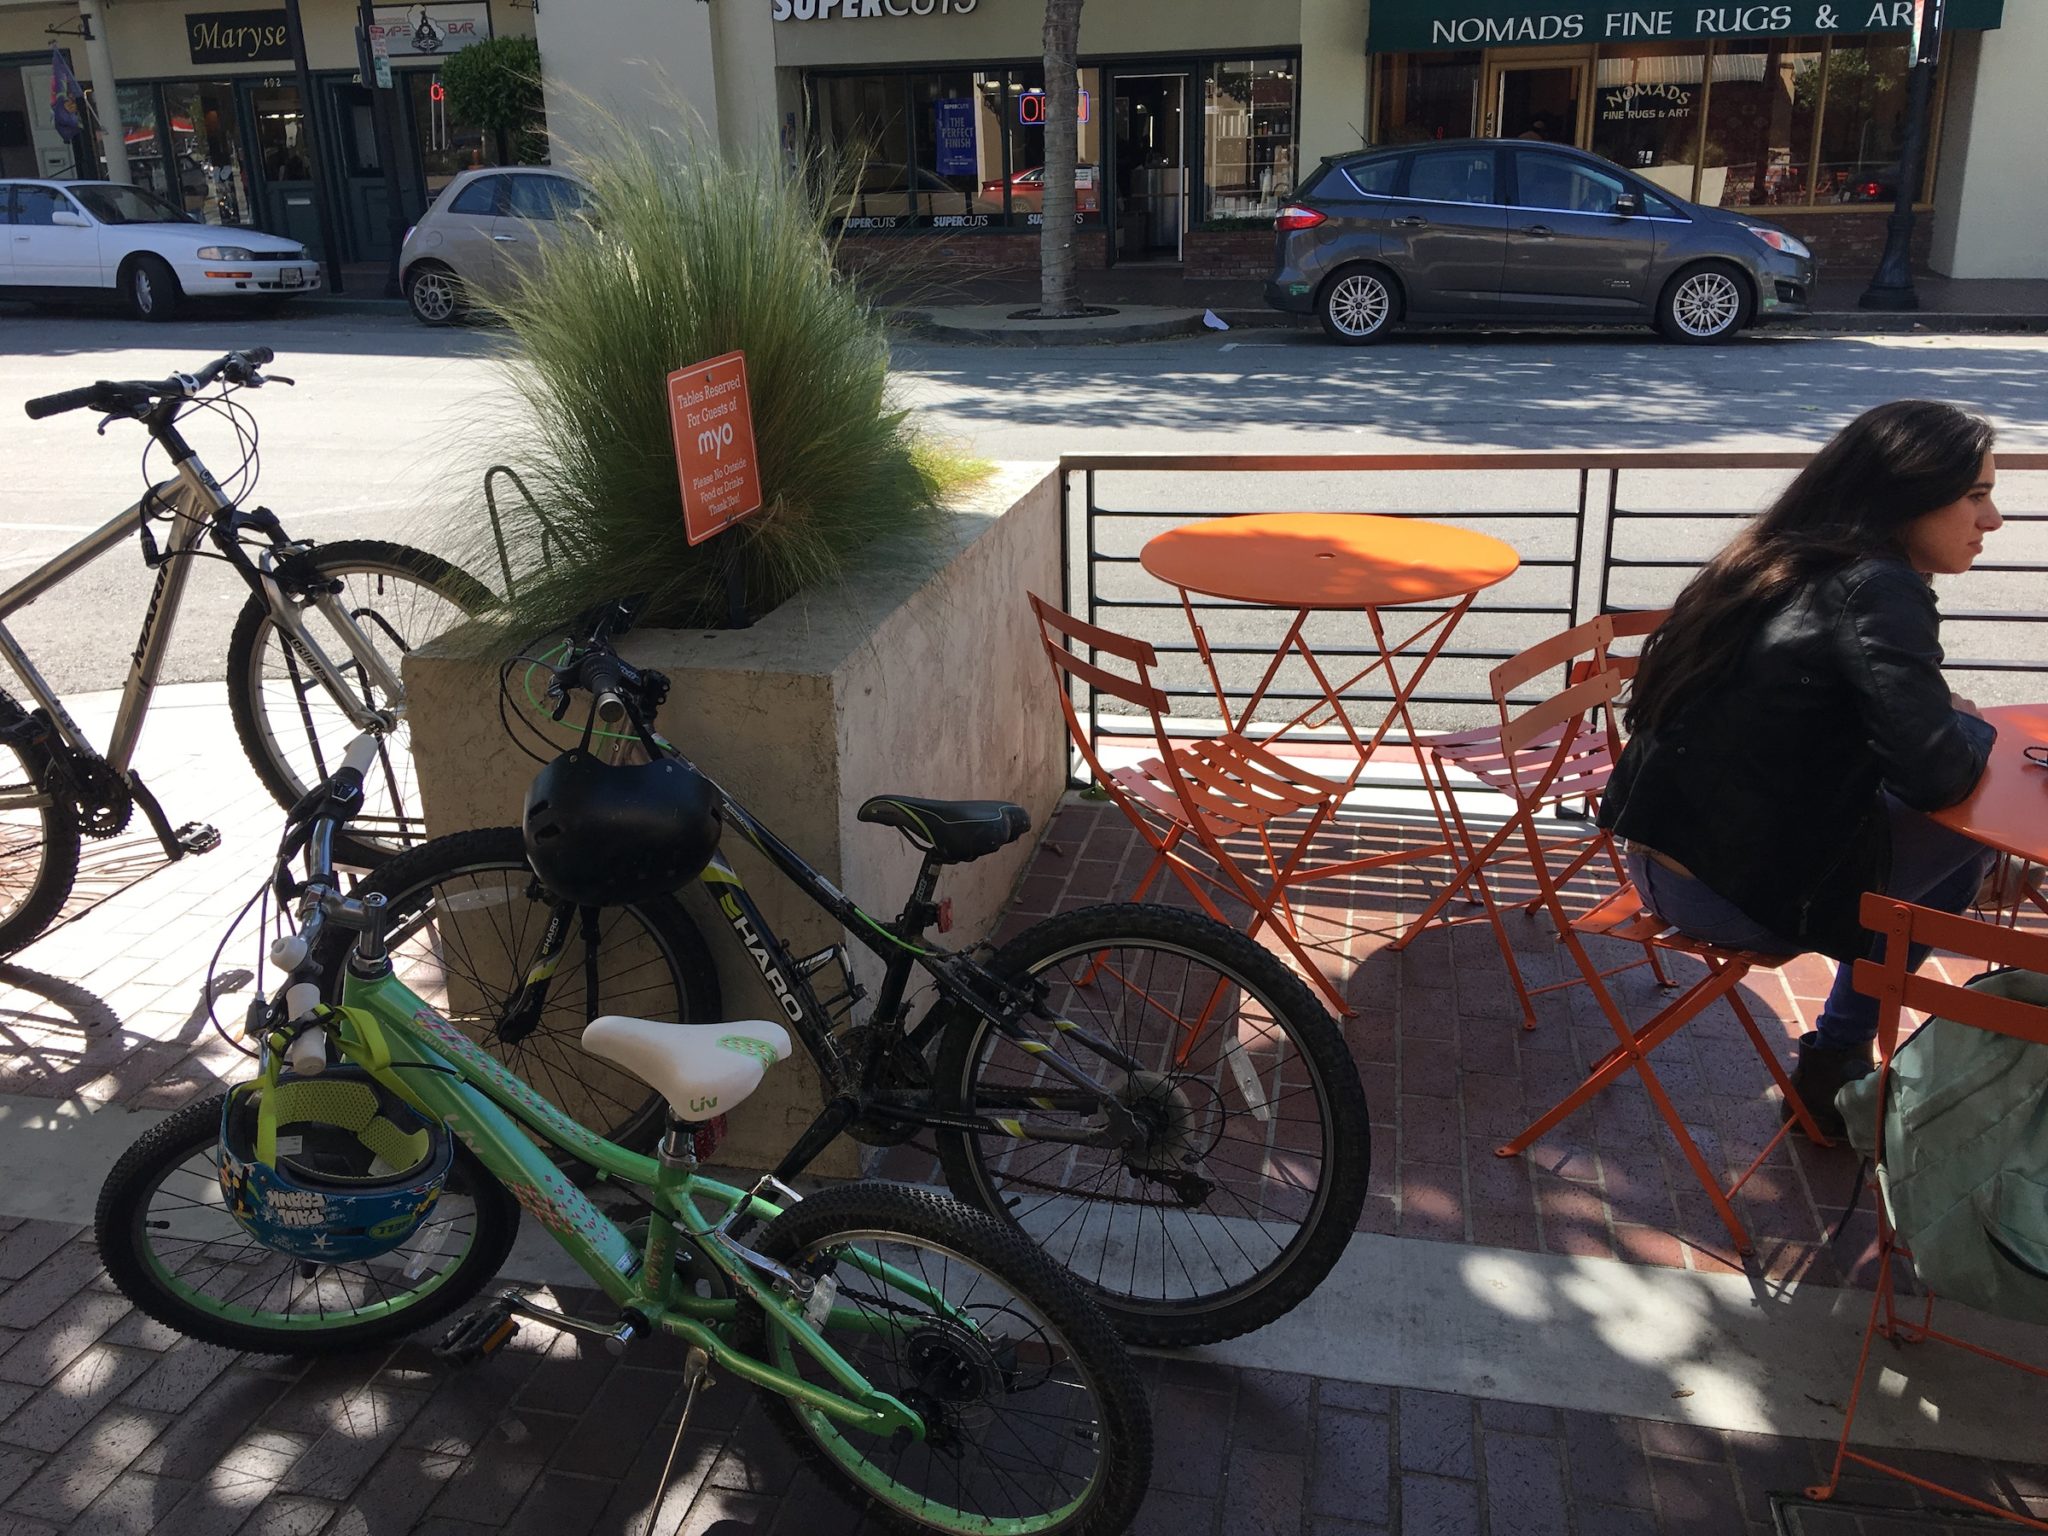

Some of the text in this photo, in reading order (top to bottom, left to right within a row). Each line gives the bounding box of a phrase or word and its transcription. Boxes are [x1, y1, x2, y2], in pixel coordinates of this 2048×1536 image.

[385, 22, 477, 37] APE BAR
[1432, 1, 1914, 43] NOMADS FINE RUGS & AR
[193, 21, 287, 57] Maryse
[1605, 83, 1691, 107] NOMADS
[950, 117, 965, 128] THE
[1602, 110, 1625, 120] FINE
[1627, 109, 1656, 119] RUGS
[1667, 108, 1690, 118] ART
[942, 127, 973, 138] PERFECT
[944, 138, 971, 149] FINISH
[933, 215, 988, 227] SUPERCUTS
[677, 374, 741, 409] Tables Reserved
[687, 396, 737, 428] For Guests of
[698, 422, 733, 460] myo
[693, 458, 747, 490] Please No Outside
[700, 476, 744, 503] Food or Drinks
[543, 917, 560, 947] HARO
[733, 915, 803, 1022] HARO
[267, 1189, 326, 1208] FRANK
[277, 1207, 326, 1226] PAUL
